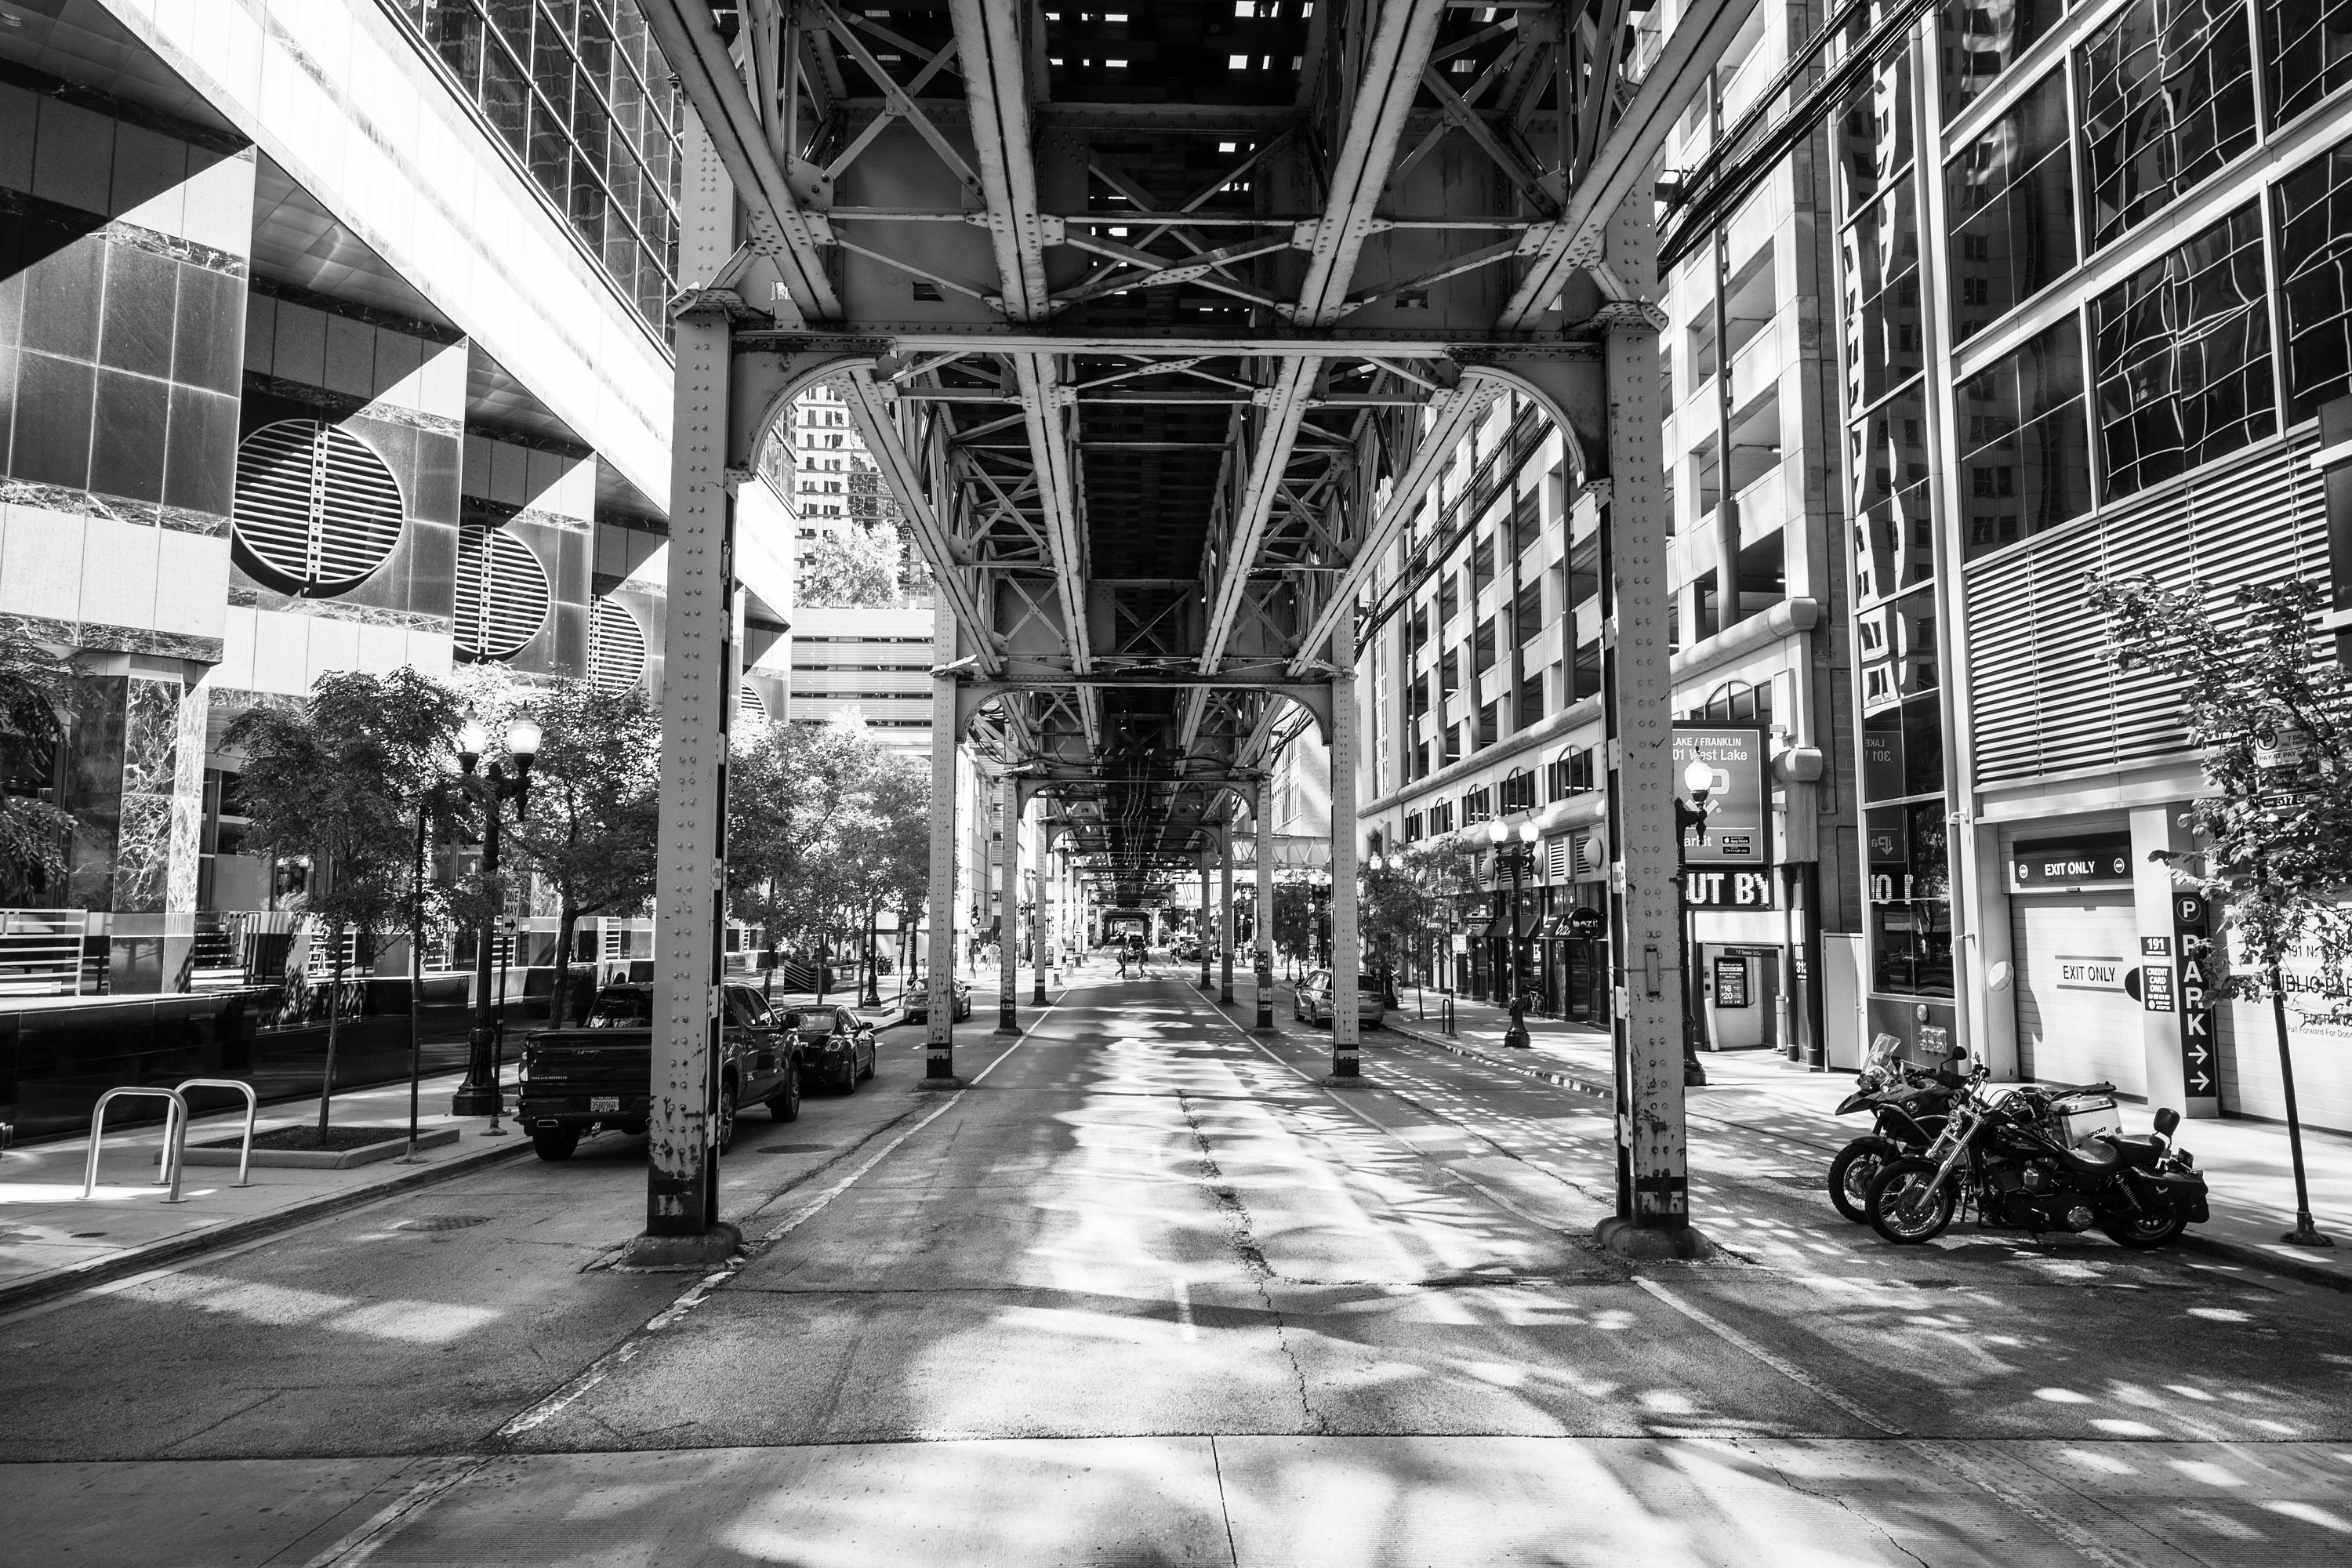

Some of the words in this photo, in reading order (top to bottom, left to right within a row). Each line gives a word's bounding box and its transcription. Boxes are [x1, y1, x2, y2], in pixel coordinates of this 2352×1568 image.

[1700, 738, 1742, 747] FRANKLIN
[1720, 750, 1748, 761] Lake
[2276, 796, 2294, 806] 517
[2045, 863, 2067, 877] EXIT
[2067, 861, 2096, 876] ONLY
[1686, 873, 1725, 904] UT
[1733, 873, 1769, 904] BY
[505, 891, 519, 902] ONE
[505, 904, 519, 916] WAY
[2147, 938, 2165, 951] 191
[2063, 965, 2085, 981] EXIT
[2088, 967, 2115, 982] ONLY
[2147, 967, 2168, 977] CREDIT
[2149, 976, 2166, 985] CARD
[2182, 934, 2207, 1036] PARK
[2149, 985, 2167, 993] ONLY
[2287, 1025, 2298, 1033] Pull
[2325, 1028, 2336, 1037] For
